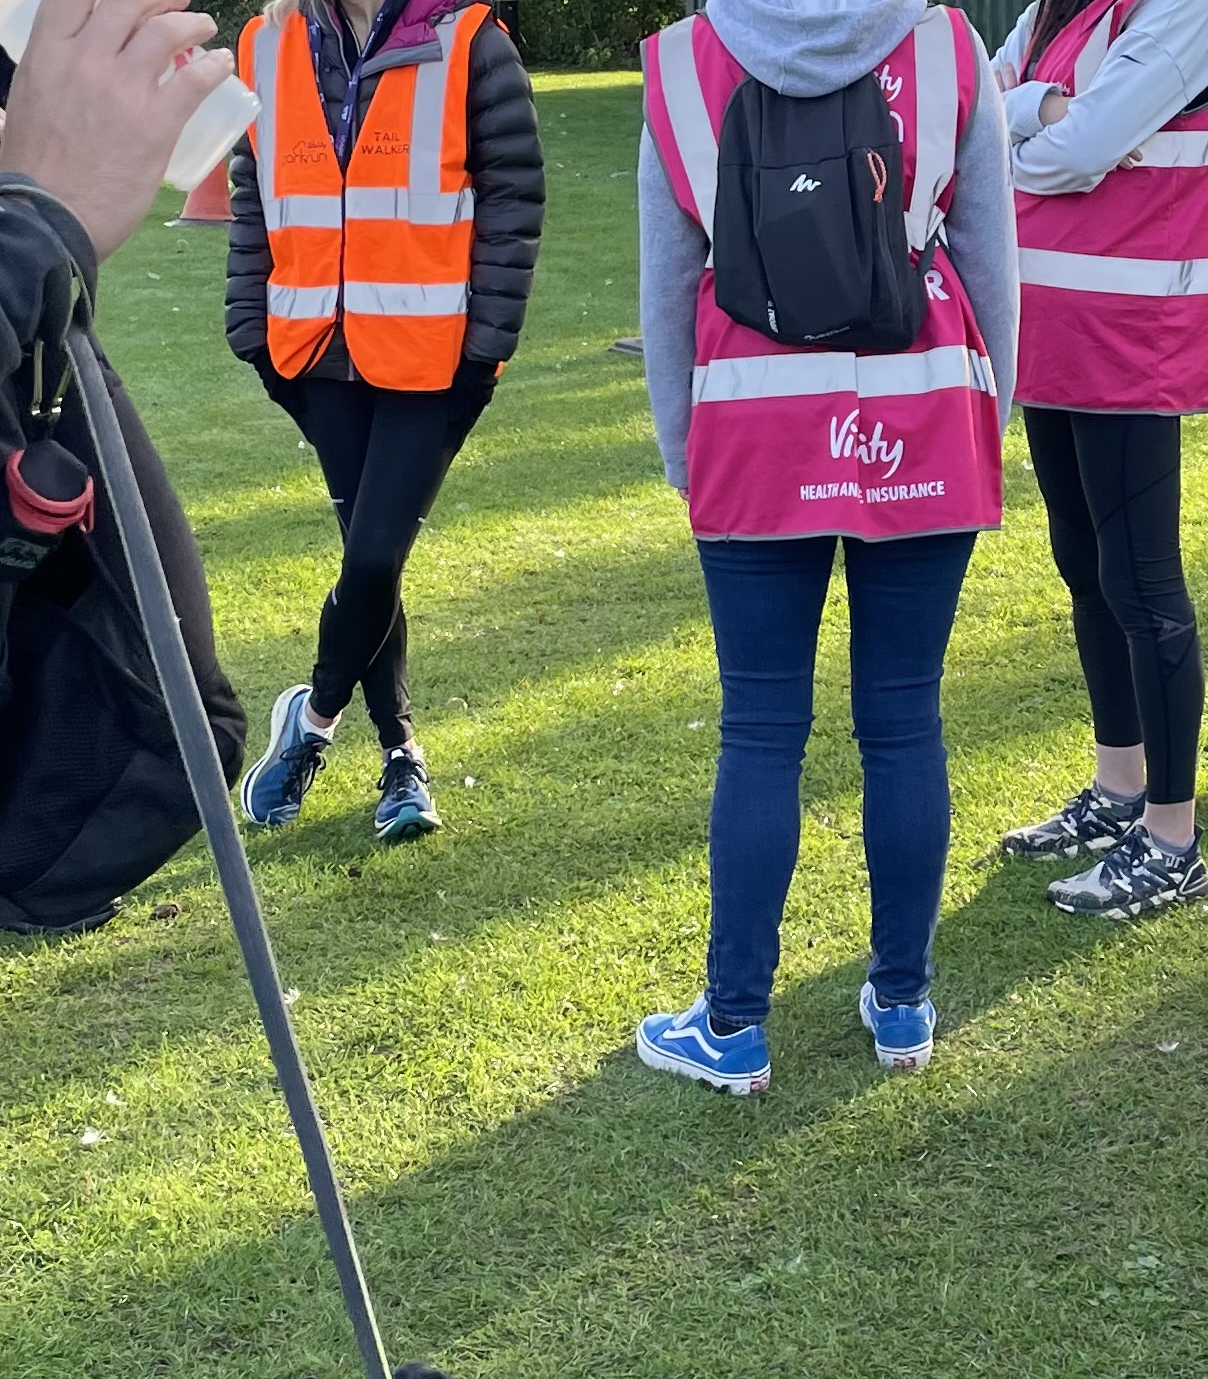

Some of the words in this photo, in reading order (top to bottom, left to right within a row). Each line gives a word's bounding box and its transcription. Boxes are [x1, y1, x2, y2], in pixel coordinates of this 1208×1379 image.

[374, 132, 400, 141] TAIL
[361, 145, 410, 155] WALKER
[866, 480, 946, 504] INSURANCE
